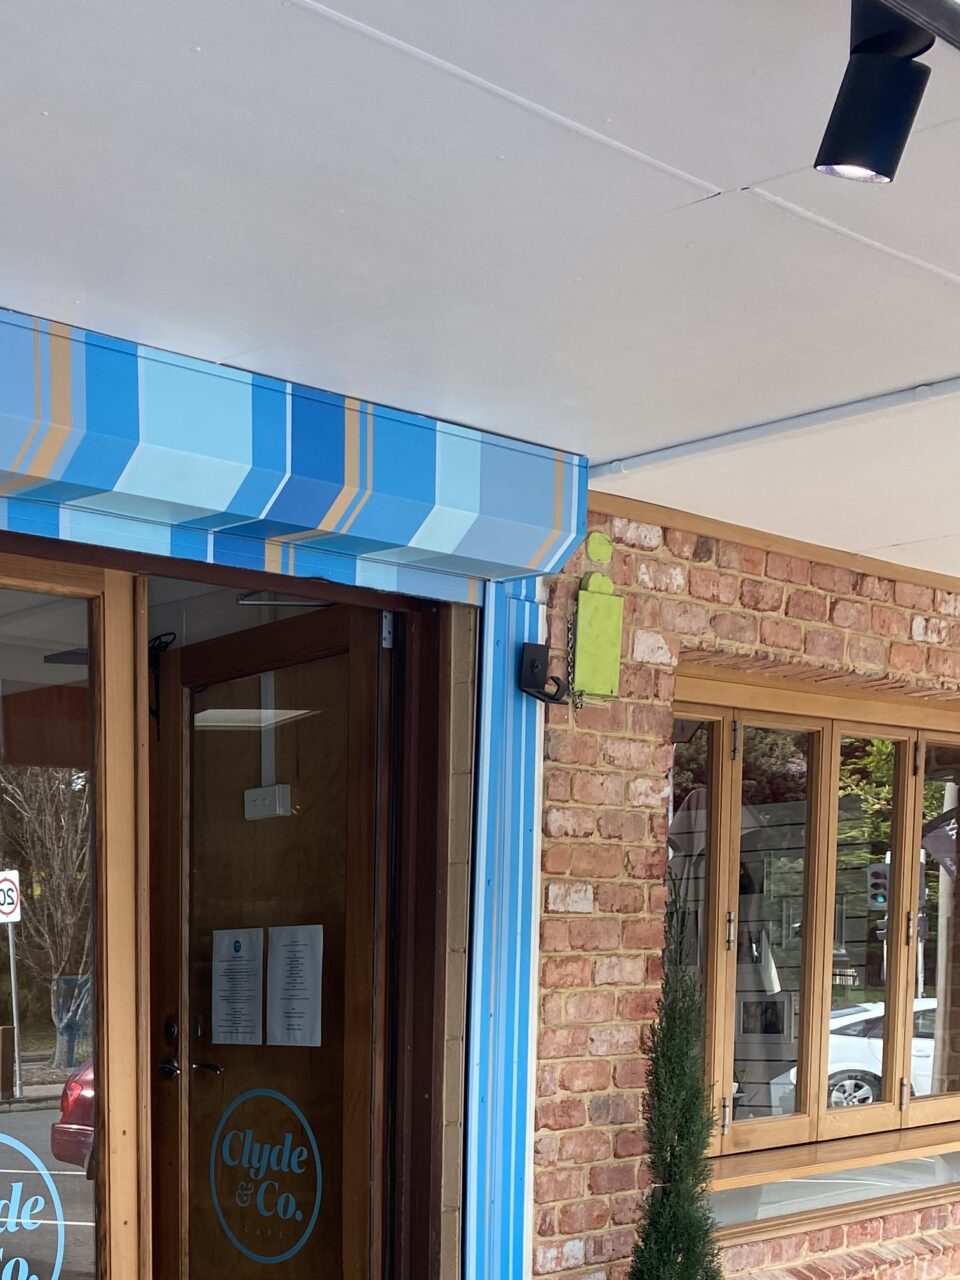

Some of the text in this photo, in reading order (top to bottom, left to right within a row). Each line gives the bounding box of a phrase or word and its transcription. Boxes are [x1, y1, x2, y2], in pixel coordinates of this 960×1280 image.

[222, 1129, 309, 1180] Clyde
[235, 1179, 303, 1222] & Co.
